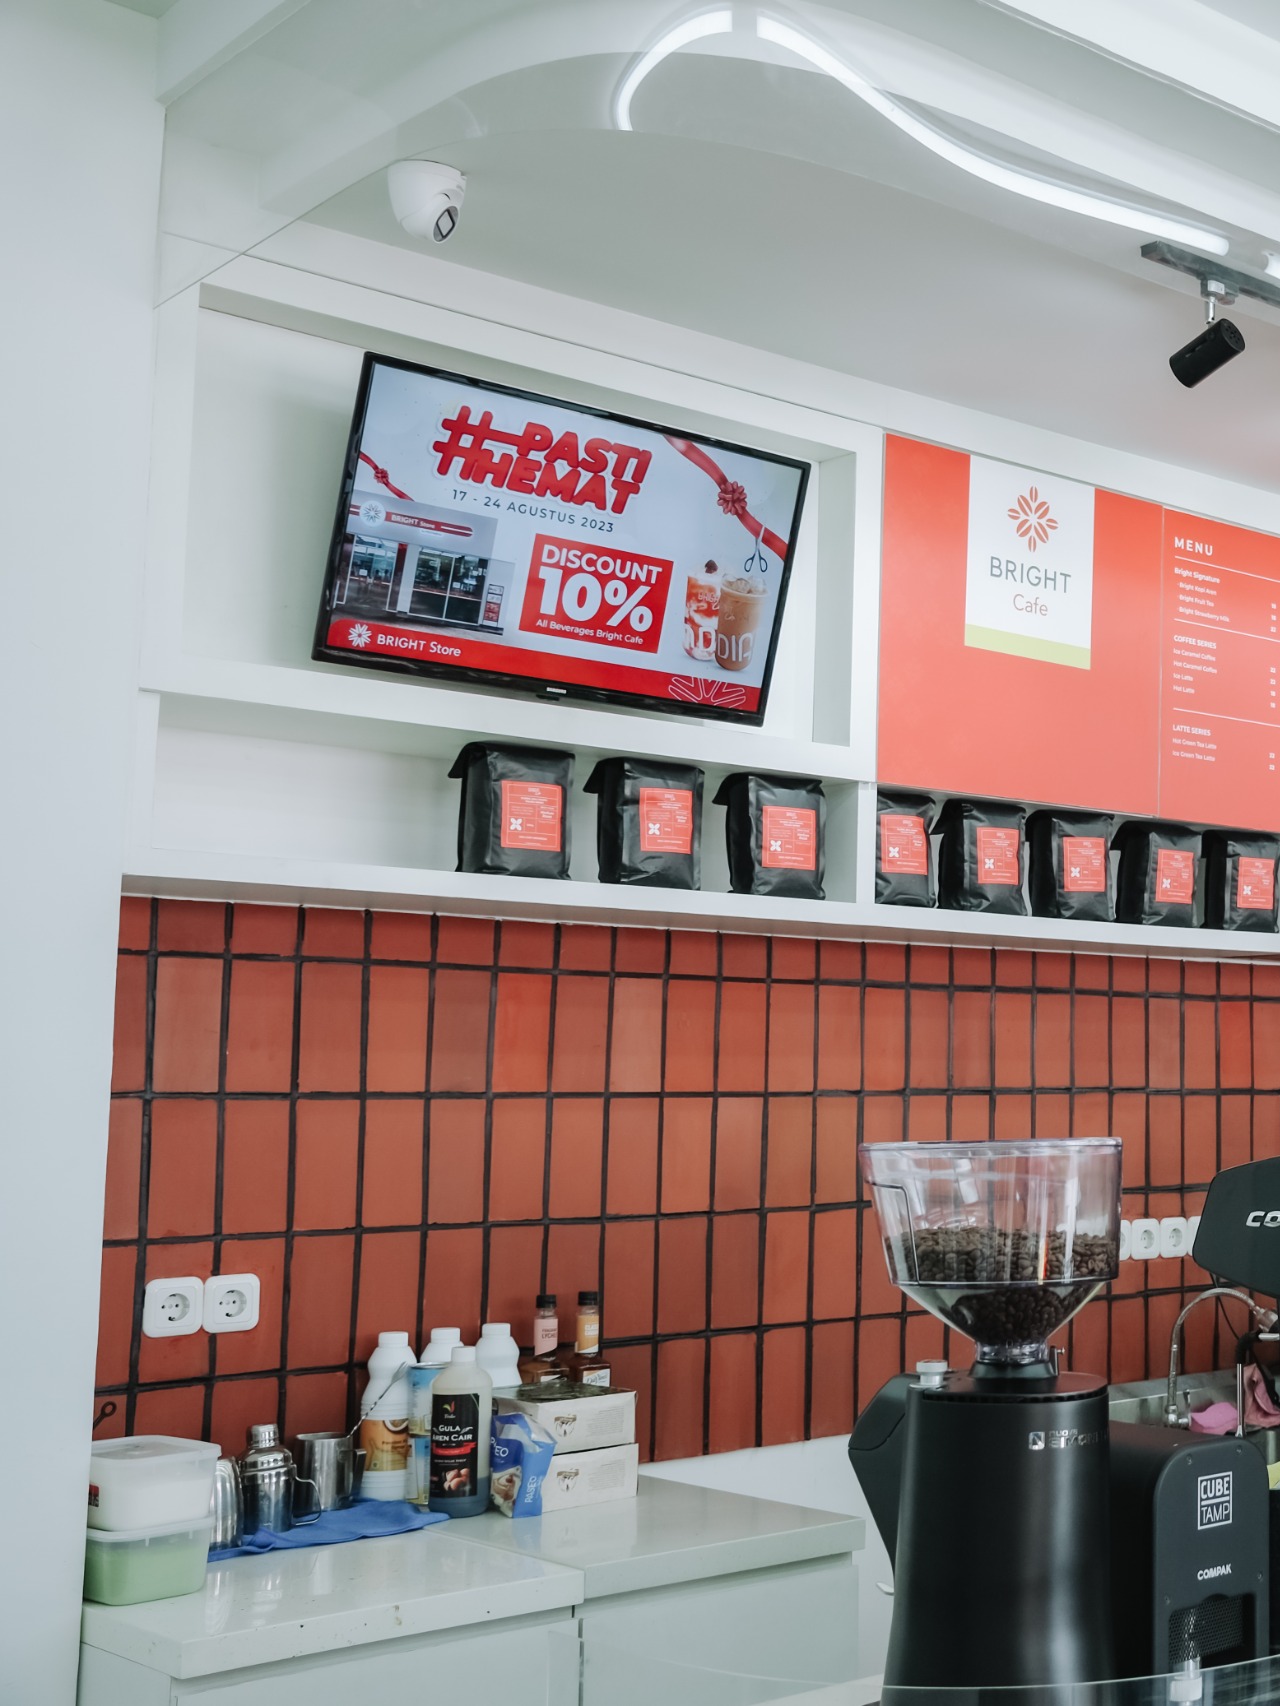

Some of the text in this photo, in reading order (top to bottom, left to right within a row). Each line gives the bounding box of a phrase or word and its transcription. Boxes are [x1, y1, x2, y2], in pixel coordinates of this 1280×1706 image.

[471, 449, 641, 515] HEMAT
[391, 514, 419, 527] BRIGHT
[453, 489, 467, 501] 17
[484, 496, 501, 509] 24
[507, 502, 576, 525] AGUSTUS
[581, 517, 614, 533] 2023
[1174, 536, 1214, 556] MENU
[541, 544, 663, 584] DISCOUNT
[989, 556, 1072, 593] BRIGHT
[1174, 567, 1220, 583] Bright Signature
[538, 565, 653, 632] 10%
[1012, 593, 1049, 616] Cafe
[1179, 594, 1194, 603] Bright
[535, 618, 644, 645] All Beverages Bright Cafe
[1173, 635, 1217, 649] COFFEE SERIES
[376, 633, 461, 657] BRIGHT Store
[1172, 724, 1211, 736] LATTE SERIES
[438, 1424, 460, 1432] GULA
[525, 1475, 537, 1503] PASEO
[1200, 1476, 1230, 1500] CUBE
[1200, 1502, 1230, 1524] TAMP
[1197, 1563, 1232, 1581] COMPAK
